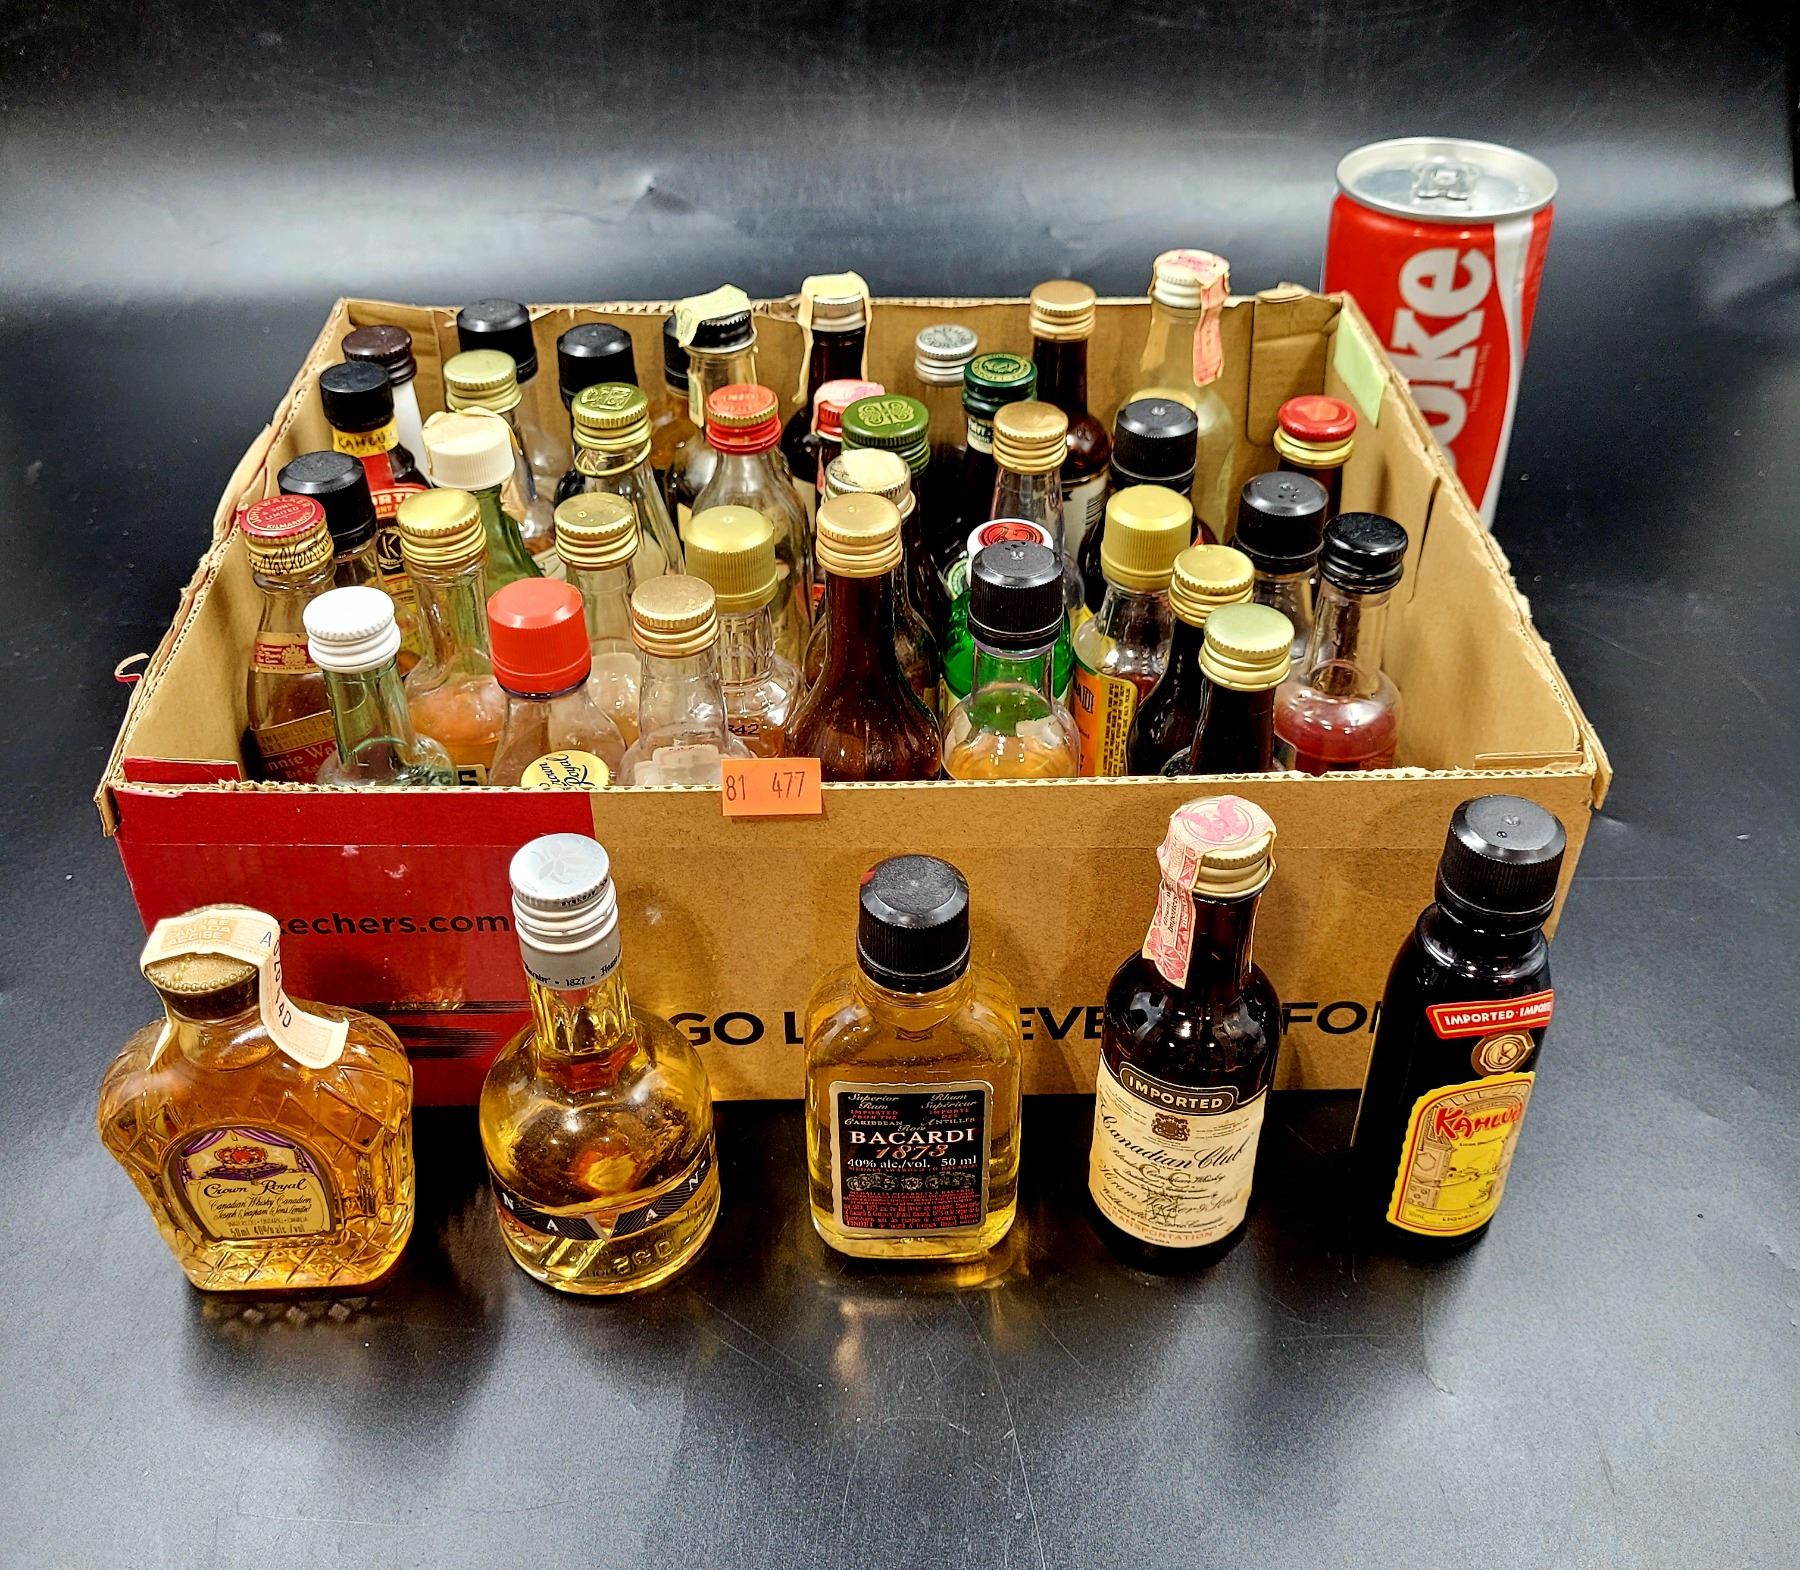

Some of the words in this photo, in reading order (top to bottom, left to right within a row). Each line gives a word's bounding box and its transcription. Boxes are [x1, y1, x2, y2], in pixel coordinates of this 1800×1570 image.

[1388, 248, 1493, 475] oke
[267, 755, 304, 771] nnie
[726, 775, 745, 801] 81
[772, 771, 805, 798] 477
[281, 913, 510, 935] echers.com
[566, 977, 586, 986] 1827
[668, 1011, 765, 1046] GO
[1019, 1006, 1104, 1040] EVE
[1444, 1010, 1515, 1026] IMPORTED
[848, 1094, 899, 1102] Superior
[1129, 1076, 1223, 1110] IMPORTED
[859, 1102, 889, 1110] Rum
[844, 1118, 903, 1126] CARIBBEAN
[848, 1128, 976, 1145] BACARDI
[1101, 1113, 1192, 1169] Canadian
[1194, 1136, 1252, 1169] Club
[875, 1144, 949, 1160] 1873
[847, 1159, 877, 1167] 40%
[880, 1158, 931, 1168] alc./vol.
[940, 1157, 957, 1167] 50
[960, 1155, 977, 1165] ml
[204, 1183, 248, 1198] Crown
[252, 1178, 308, 1195] Royal
[248, 1196, 274, 1209] Whisky
